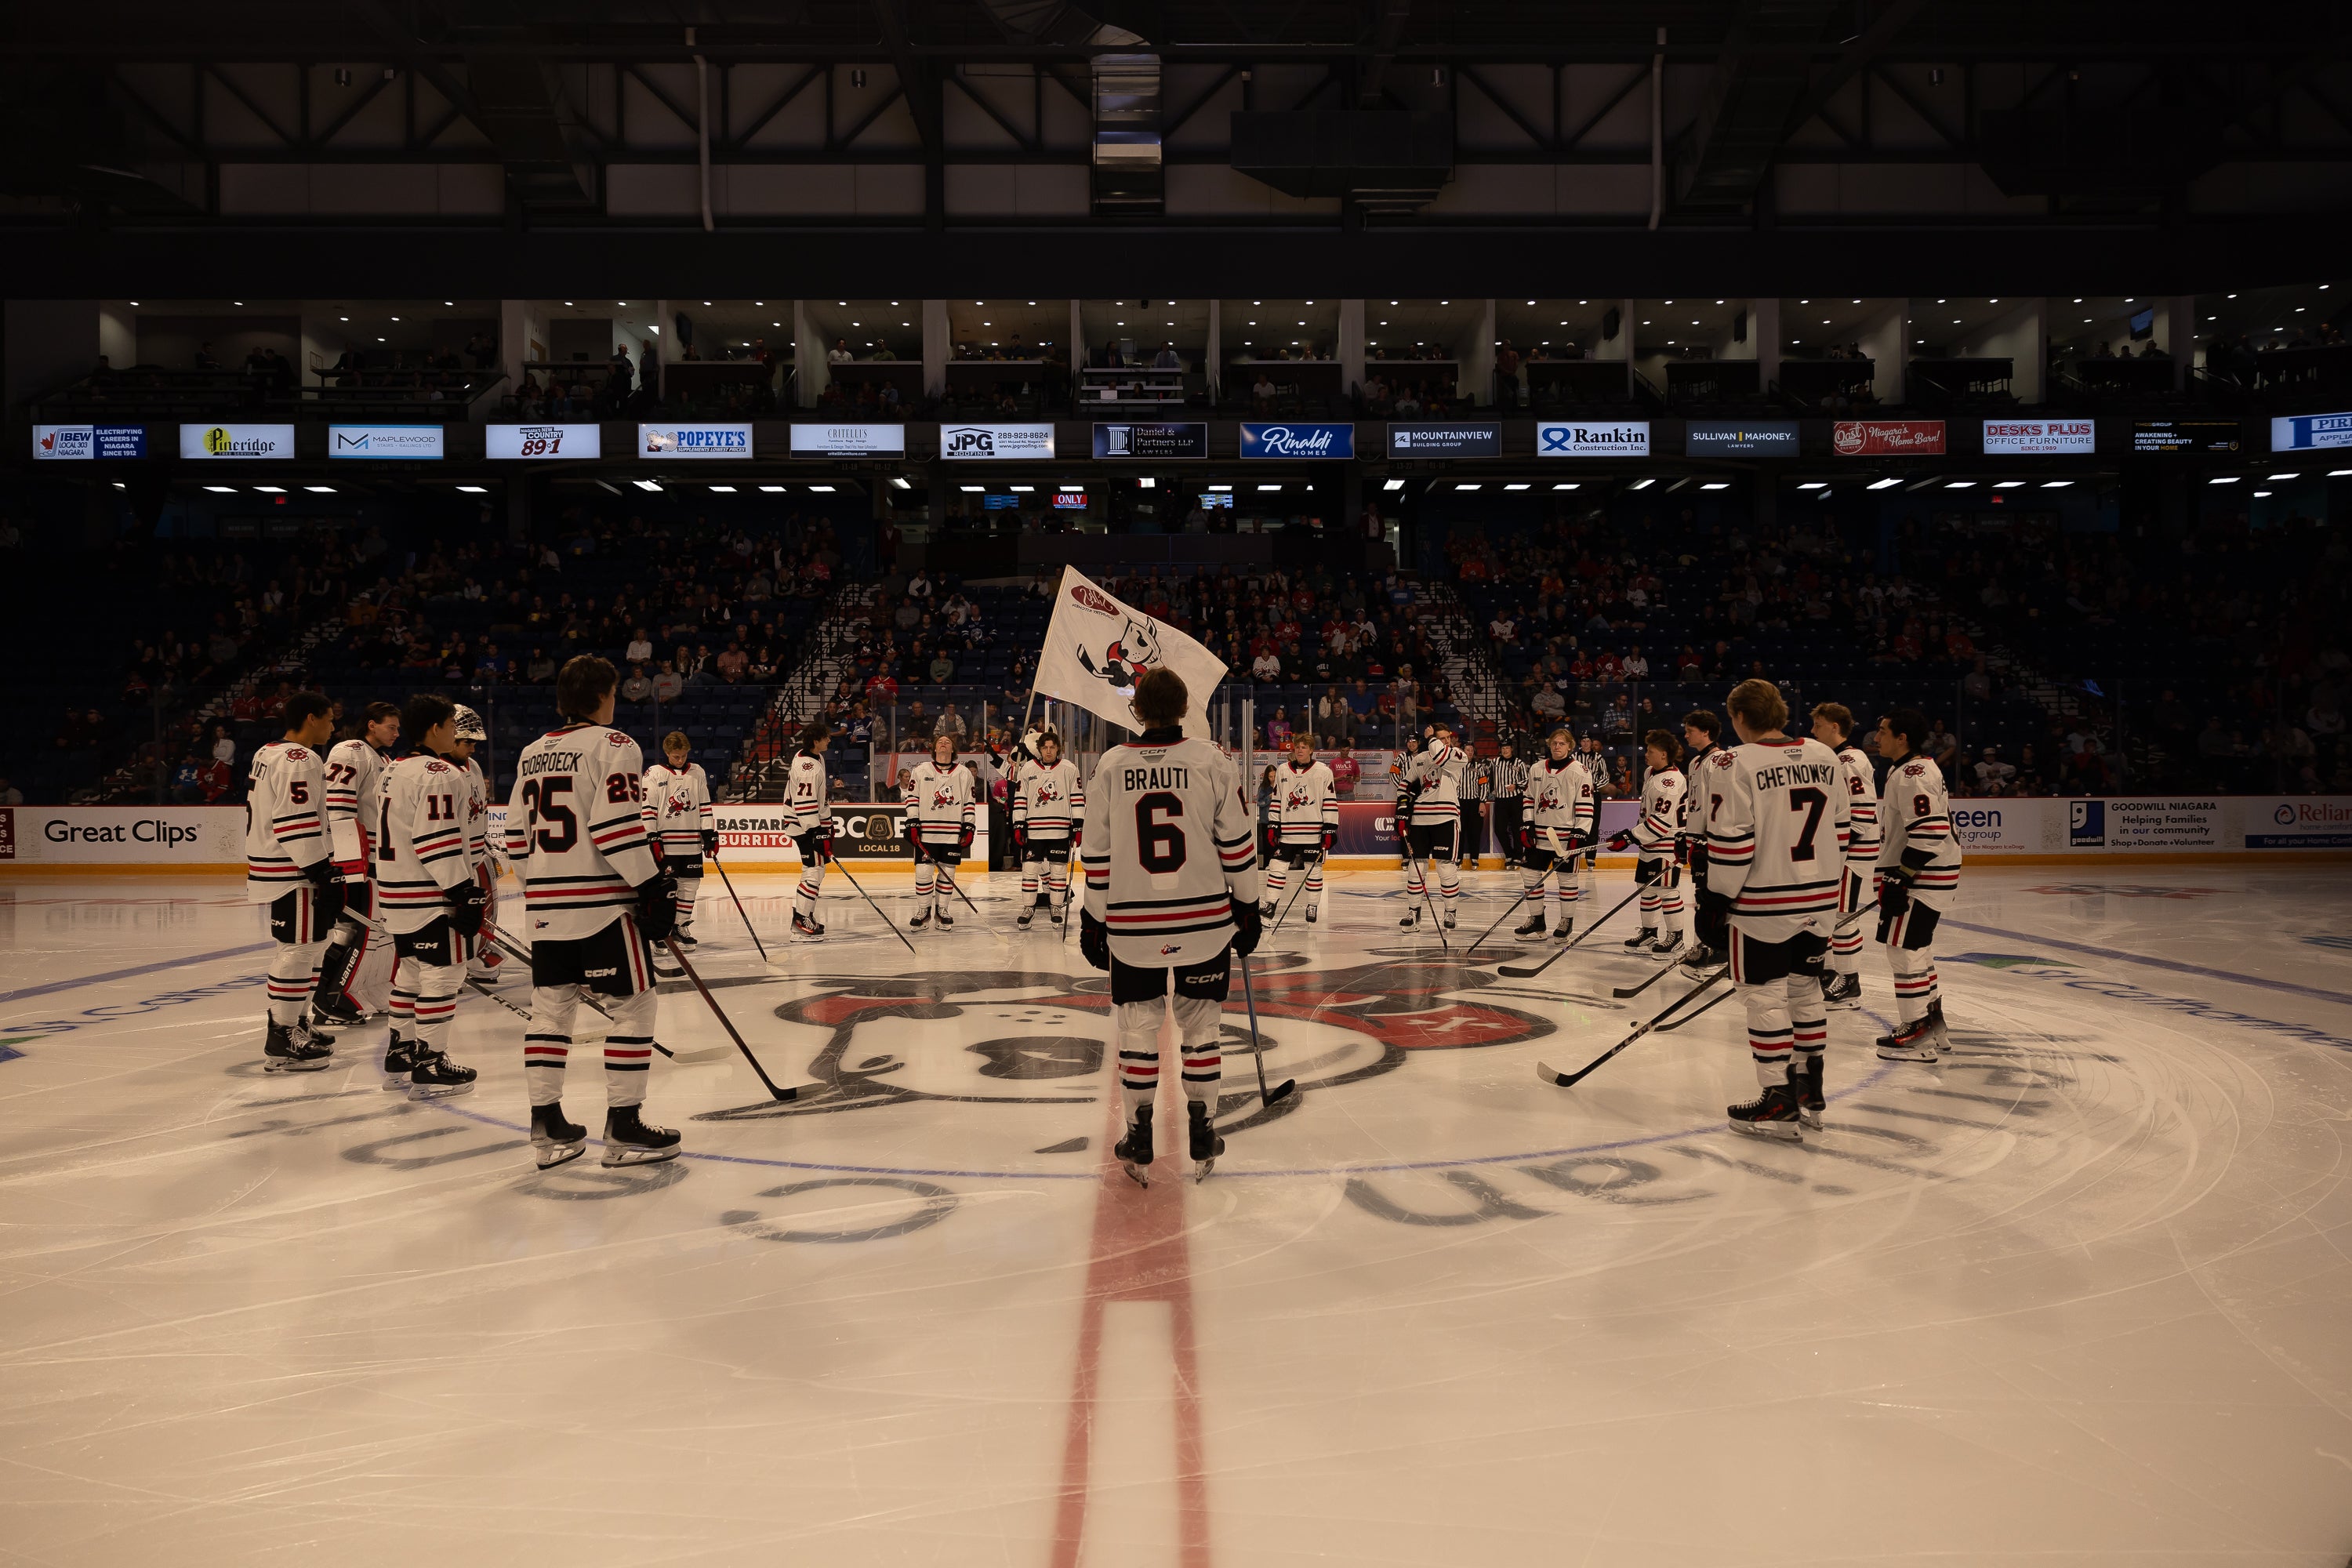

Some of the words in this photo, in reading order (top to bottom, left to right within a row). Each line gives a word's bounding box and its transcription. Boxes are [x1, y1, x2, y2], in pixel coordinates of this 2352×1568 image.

[60, 432, 92, 441] IBEW
[528, 430, 563, 439] COUNTRY
[828, 429, 867, 438] CRITELLI'S
[1137, 427, 1165, 436] Daniel
[1167, 427, 1174, 436] &
[1413, 431, 1492, 440] MOUNTAINVIEW
[1573, 427, 1646, 444] Rankin
[1835, 423, 1861, 444] Oast
[1868, 426, 1909, 440] Niagara's
[1986, 424, 2043, 437] DESKS
[2048, 423, 2092, 436] PLUS
[212, 428, 275, 453] Pineridge
[677, 431, 746, 446] POPEYE'S
[948, 432, 993, 452] JPG
[1137, 437, 1176, 447] Partners
[1261, 427, 1333, 453] Rinaldi
[1888, 434, 1914, 446] Home
[1915, 430, 1940, 444] Barn!
[1058, 495, 1083, 504] ONLY
[325, 763, 357, 785] 77
[1124, 768, 1188, 791] BRAUTI
[1756, 764, 1834, 791] CHEYNOWSKI
[290, 781, 309, 805] 5
[606, 772, 641, 804] 25
[797, 782, 813, 797] 71
[427, 795, 455, 821] 11
[1654, 797, 1672, 815] 23
[1711, 793, 1724, 822] 7
[1913, 794, 1931, 816] 8
[2111, 803, 2166, 811] GOODWILL
[2169, 802, 2216, 811] NIAGARA
[1789, 786, 1828, 862] 7
[2122, 816, 2162, 826] Helping
[2165, 815, 2207, 824] Families
[45, 820, 126, 842] Great
[132, 820, 198, 848] Clips
[1134, 791, 1187, 874] 6
[2153, 826, 2210, 836] community
[717, 834, 791, 846] BURRITO
[2071, 836, 2104, 846] goodwill
[2288, 838, 2306, 847] your
[583, 967, 618, 978] CCM
[1185, 972, 1225, 985] CCM
